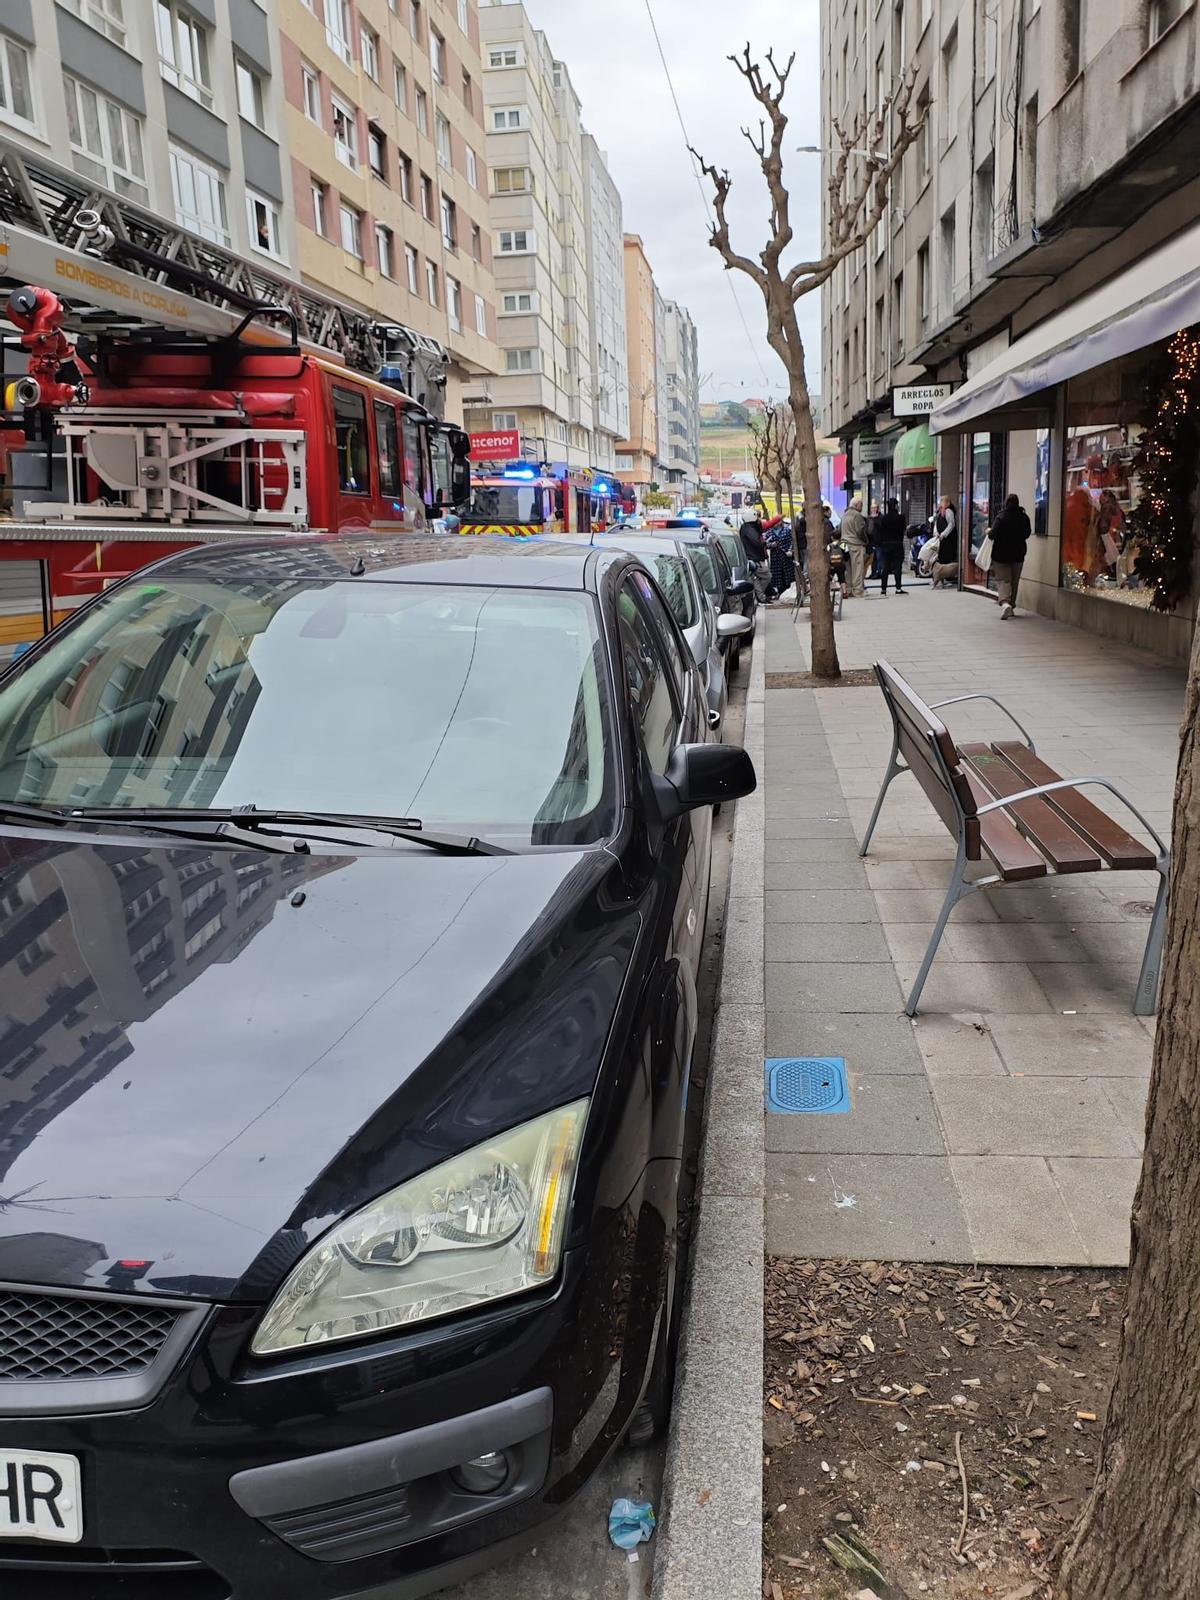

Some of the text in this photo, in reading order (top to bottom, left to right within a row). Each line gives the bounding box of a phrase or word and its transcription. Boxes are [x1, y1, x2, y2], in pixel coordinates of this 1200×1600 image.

[55, 259, 130, 298] BOMBEROS
[130, 288, 141, 302] A
[901, 389, 944, 400] ARREGLOS
[912, 401, 934, 411] ROPA
[480, 436, 514, 447] cenor
